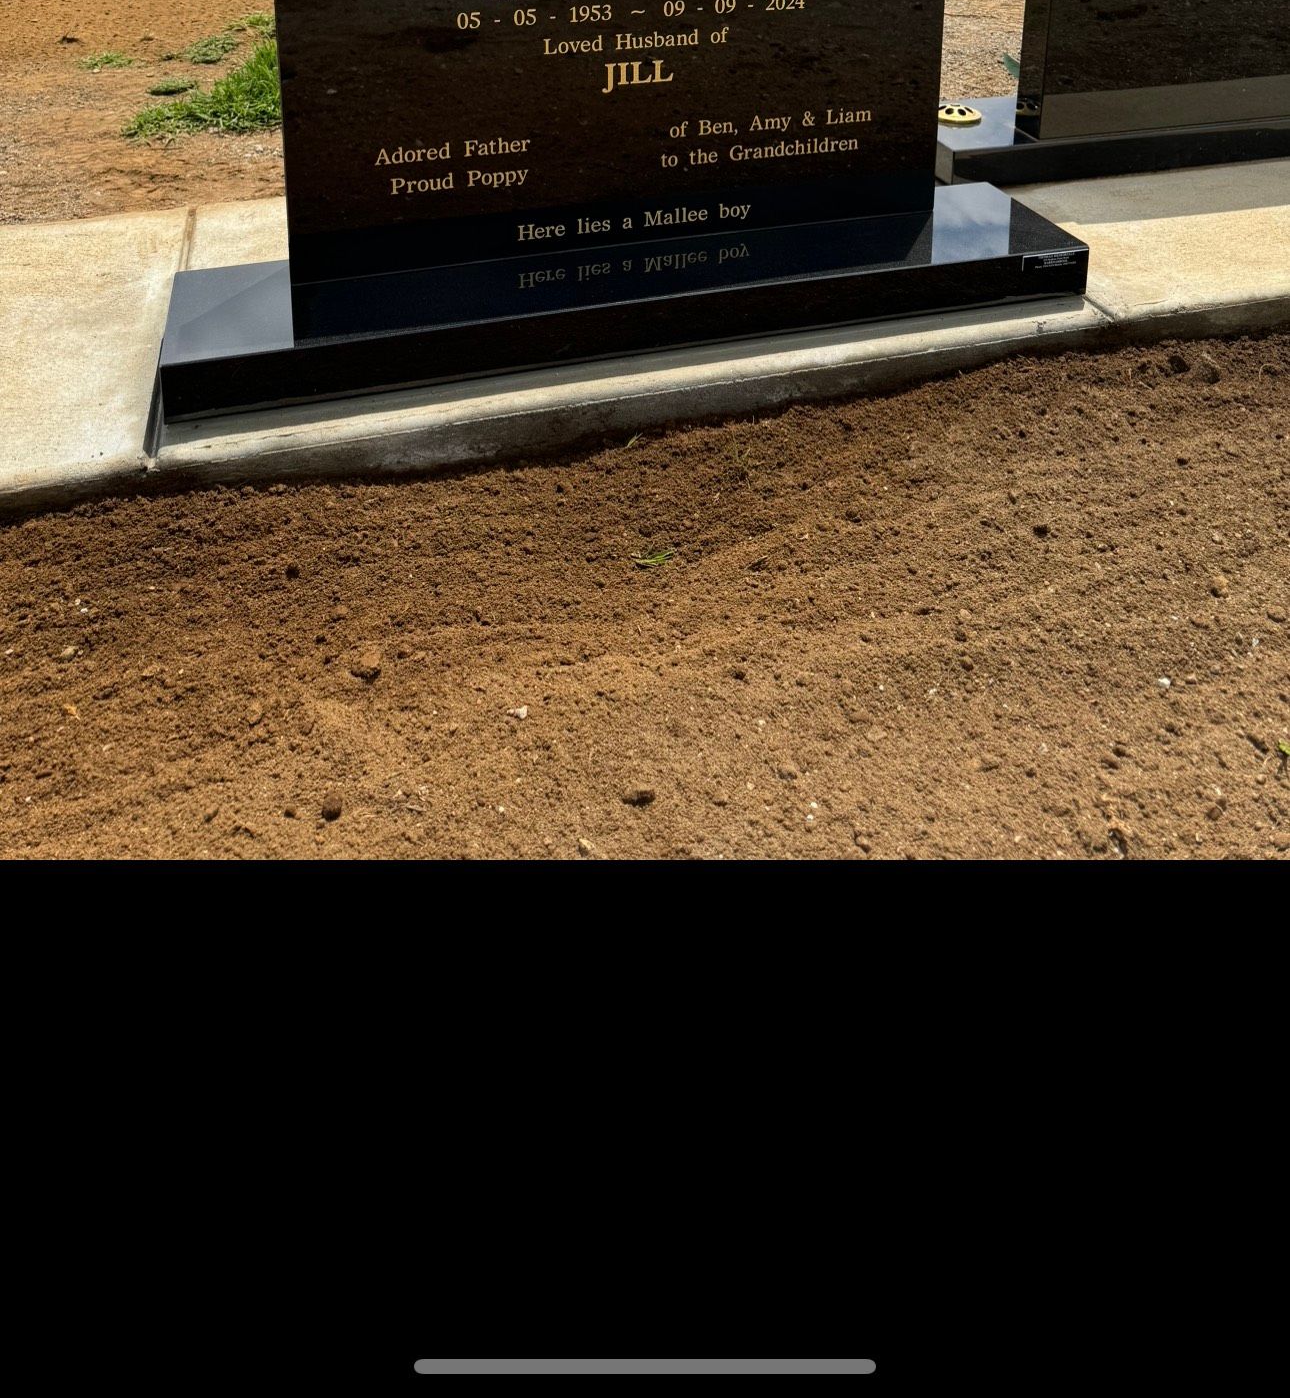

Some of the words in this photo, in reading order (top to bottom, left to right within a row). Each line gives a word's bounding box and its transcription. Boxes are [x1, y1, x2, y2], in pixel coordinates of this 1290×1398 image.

[456, 11, 481, 30] 05
[513, 8, 537, 26] 05
[569, 4, 612, 23] 1953
[663, 0, 688, 17] 09
[543, 34, 603, 55] Loved
[615, 28, 699, 51] Husband
[710, 26, 730, 44] of
[601, 59, 674, 94] JILL
[669, 120, 689, 139] of
[698, 119, 739, 138] Ben,
[749, 114, 792, 133] Amy
[801, 110, 816, 127] &
[826, 107, 872, 125] Liam
[374, 142, 451, 166] Adored
[464, 136, 531, 157] Father
[660, 152, 679, 168] to
[688, 148, 718, 165] the
[729, 136, 858, 162] Grandchildren
[390, 172, 454, 195] Proud
[467, 169, 529, 189] Poppy
[517, 223, 566, 241] Here
[577, 217, 611, 235] lies
[621, 217, 633, 229] a
[643, 207, 708, 227] Mallee
[719, 203, 751, 220] boy
